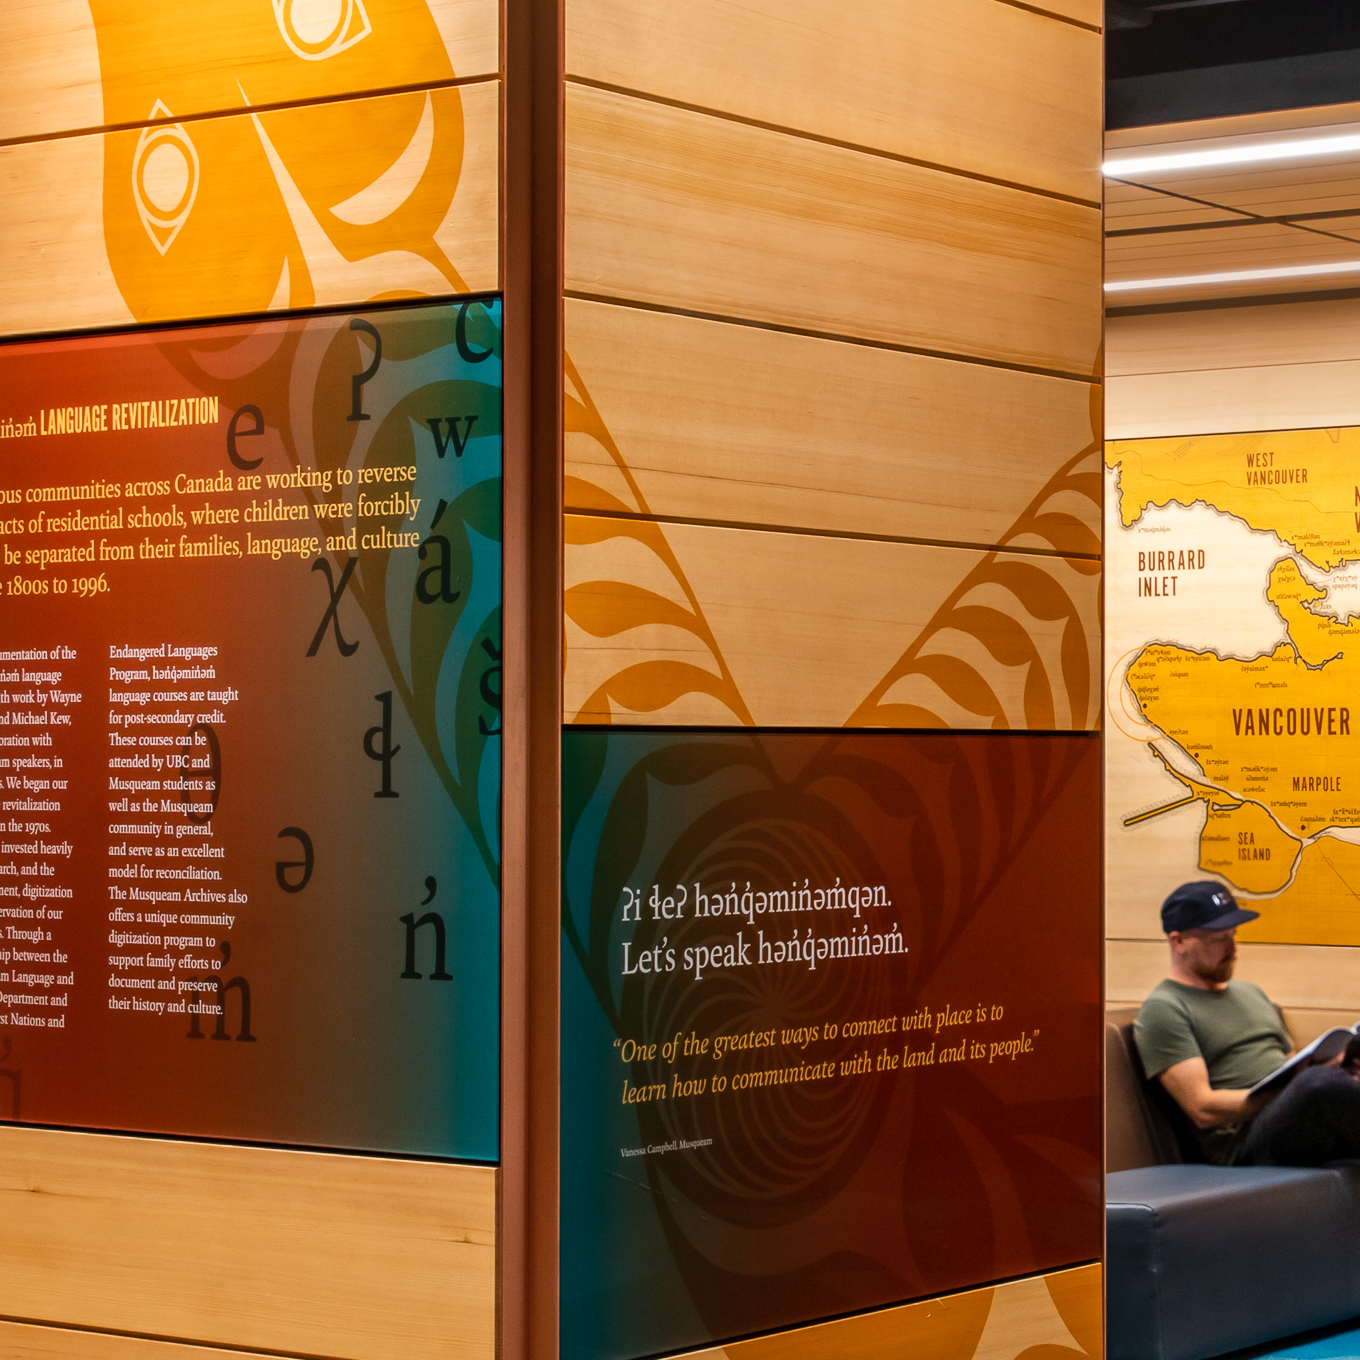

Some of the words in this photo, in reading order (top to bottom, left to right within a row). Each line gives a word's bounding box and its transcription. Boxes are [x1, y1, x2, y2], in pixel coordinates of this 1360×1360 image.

[41, 405, 108, 435] LANGUAGE
[113, 397, 218, 430] REVITALIZATION
[426, 415, 478, 459] w
[1247, 452, 1274, 468] WEST
[26, 479, 121, 502] communities
[125, 479, 170, 497] across
[175, 470, 233, 494] Canada
[238, 473, 261, 491] are
[266, 465, 332, 493] working
[337, 468, 352, 484] to
[358, 465, 417, 484] reverse
[1247, 469, 1308, 485] VANCOUVER
[29, 511, 45, 533] of
[46, 507, 123, 532] residential
[128, 504, 187, 529] schools,
[191, 503, 239, 524] where
[244, 498, 309, 523] children
[313, 501, 352, 518] were
[357, 492, 421, 521] forcibly
[4, 544, 21, 565] be
[25, 540, 95, 570] separated
[99, 539, 135, 561] from
[139, 537, 175, 559] their
[179, 534, 243, 559] families,
[247, 532, 322, 560] language,
[326, 527, 357, 551] and
[361, 526, 420, 549] culture
[1138, 550, 1205, 571] BURRARD
[7, 576, 49, 596] 1800s
[53, 577, 67, 594] to
[72, 573, 110, 598] 1996.
[1138, 576, 1178, 597] INLET
[110, 643, 165, 661] Endangered
[168, 644, 218, 660] Languages
[110, 667, 150, 684] Program,
[12, 690, 35, 703] work
[37, 690, 48, 706] by
[50, 690, 82, 706] Wayne
[109, 688, 150, 705] language
[153, 690, 188, 702] courses
[190, 691, 204, 701] are
[207, 687, 238, 704] taught
[12, 711, 48, 725] Michael
[50, 712, 71, 726] Kew,
[109, 710, 122, 724] for
[124, 710, 194, 728] post-secondary
[197, 709, 226, 724] credit.
[1232, 708, 1350, 735] VANCOUVER
[109, 777, 160, 793] Musqueam
[163, 777, 203, 790] students
[205, 779, 215, 790] as
[1292, 777, 1341, 792] MARPOLE
[2, 797, 61, 811] revitalization
[9, 819, 22, 832] the
[25, 822, 51, 834] 1970s.
[1238, 832, 1254, 845] SEA
[1238, 848, 1270, 861] ISLAND
[108, 886, 127, 900] The
[129, 887, 181, 904] Musqueam
[184, 888, 226, 903] Archives
[228, 889, 248, 903] also
[622, 937, 676, 975] Let’s
[683, 931, 752, 980] speak
[109, 996, 130, 1010] their
[133, 996, 165, 1015] history
[167, 999, 185, 1013] and
[188, 1000, 223, 1015] culture.
[613, 1038, 657, 1063] “One
[662, 1032, 682, 1063] of
[684, 1031, 709, 1056] the
[713, 1028, 776, 1060] greatest
[781, 1026, 819, 1049] ways
[824, 1022, 838, 1040] to
[842, 1015, 897, 1037] connect
[902, 1007, 932, 1031] with
[935, 1004, 972, 1033] place
[976, 1003, 987, 1022] is
[991, 1005, 1004, 1020] to
[622, 1080, 667, 1104] learn
[672, 1074, 707, 1098] how
[712, 1074, 727, 1093] to
[732, 1060, 835, 1090] communicate
[840, 1051, 872, 1076] with
[877, 1048, 899, 1071] the
[903, 1043, 935, 1067] land
[939, 1039, 966, 1064] and
[970, 1040, 986, 1059] its
[989, 1029, 1039, 1063] people.”
[621, 1147, 646, 1158] Vanessa
[647, 1141, 678, 1155] Campbell,
[679, 1139, 712, 1150] Musqueam
